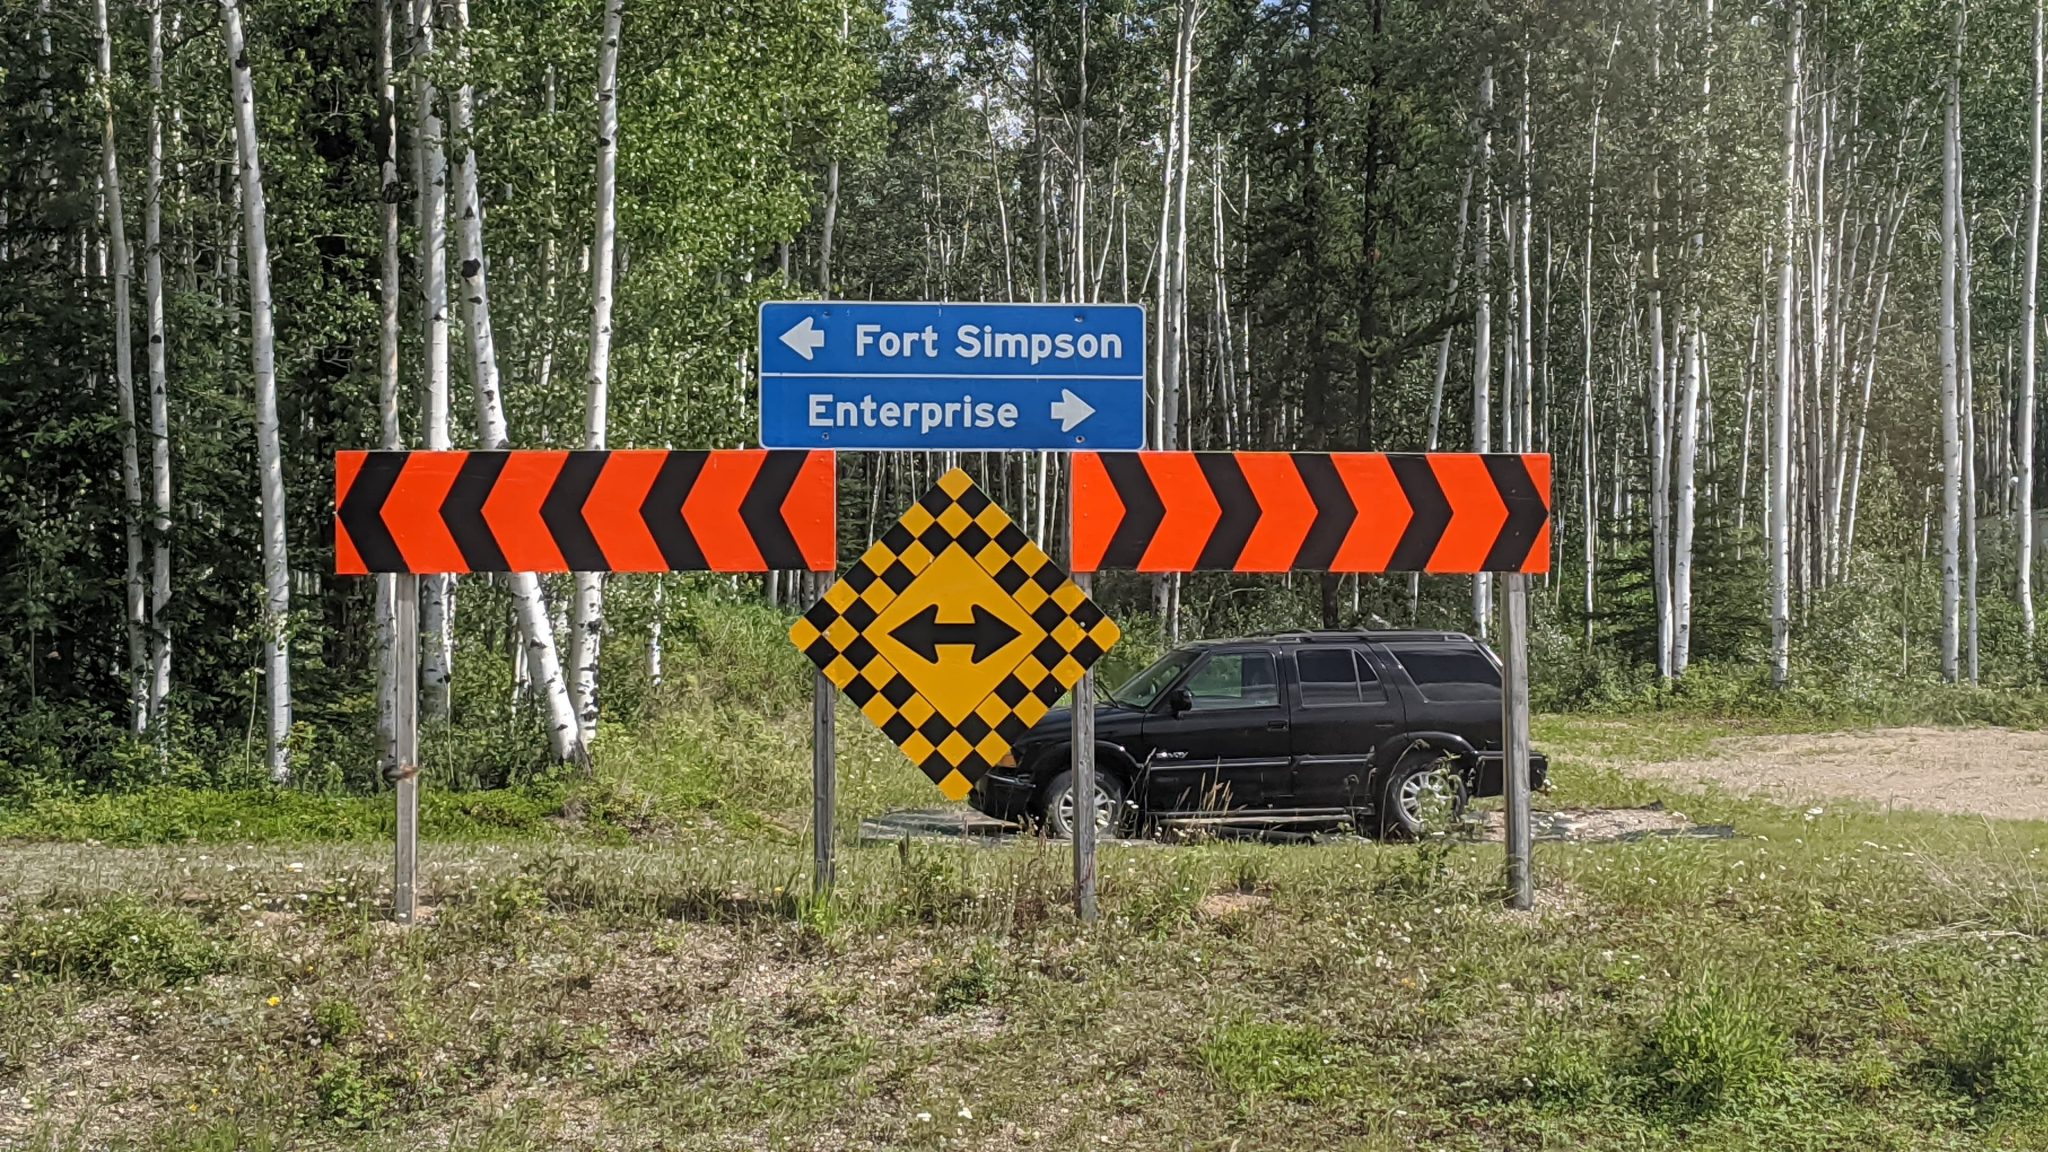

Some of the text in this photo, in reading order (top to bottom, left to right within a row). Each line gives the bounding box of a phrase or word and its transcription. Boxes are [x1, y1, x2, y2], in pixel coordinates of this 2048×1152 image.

[856, 324, 1122, 366] Fort Simpson
[809, 394, 1019, 434] Enterprise
